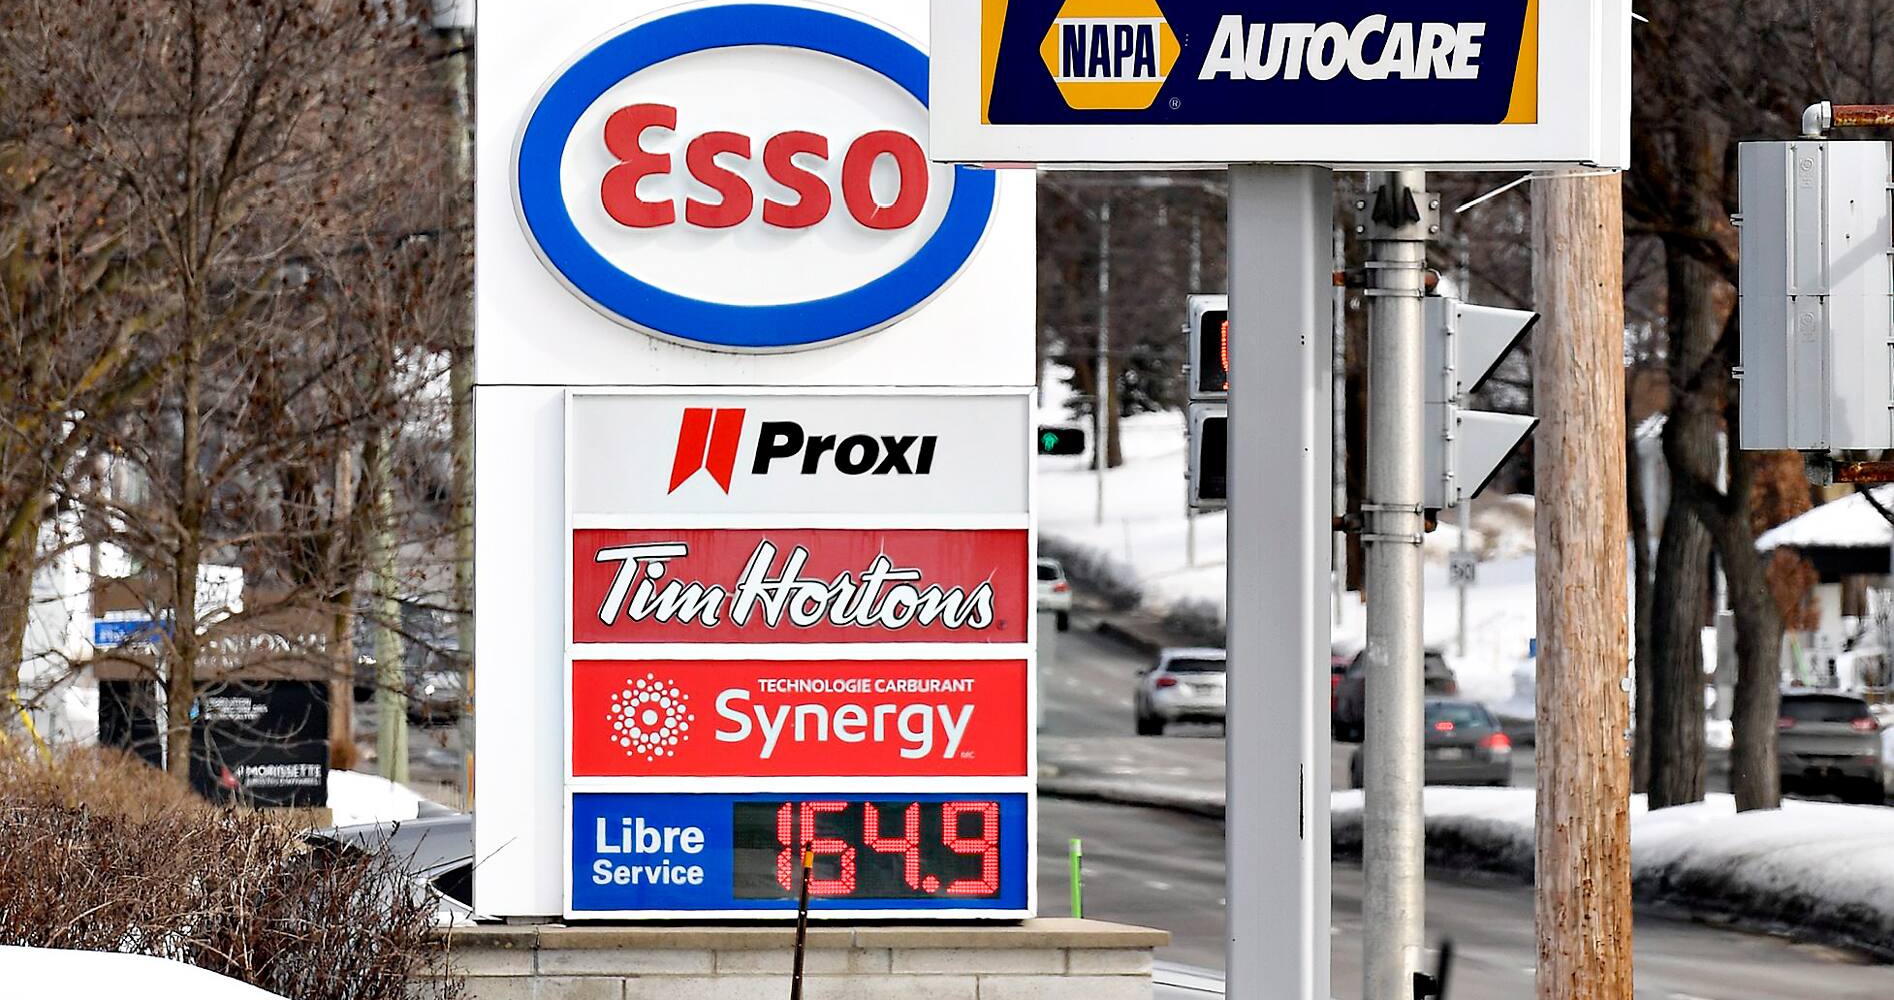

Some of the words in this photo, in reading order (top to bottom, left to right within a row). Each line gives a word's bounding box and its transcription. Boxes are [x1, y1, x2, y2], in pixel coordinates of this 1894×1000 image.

[1062, 23, 1157, 78] NAPA
[595, 542, 722, 626] Tim
[729, 539, 994, 629] Hortons
[757, 678, 871, 694] TECHNOLOGIE
[874, 678, 975, 694] CARBURANT
[714, 688, 975, 759] Synergy
[596, 817, 705, 854] Libre
[776, 801, 999, 895] 164.9
[592, 858, 705, 885] Service
